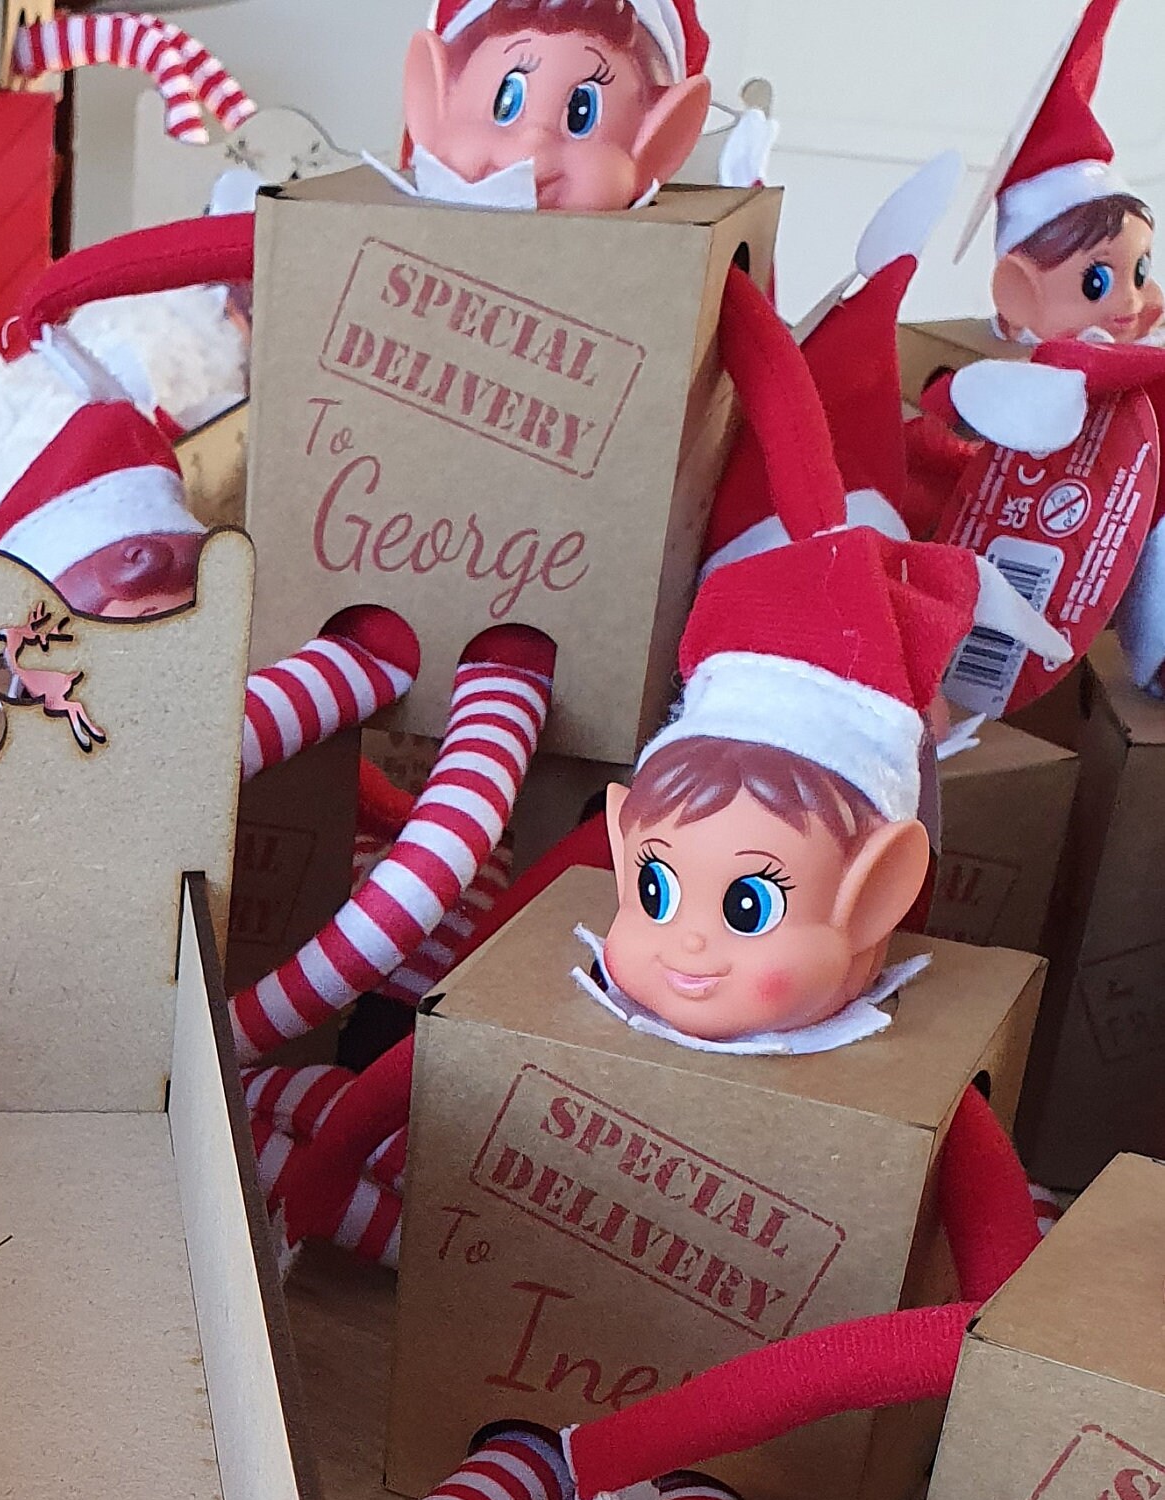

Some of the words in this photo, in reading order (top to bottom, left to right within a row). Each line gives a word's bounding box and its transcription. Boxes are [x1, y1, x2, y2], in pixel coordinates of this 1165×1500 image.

[335, 322, 596, 459] DELIVERY
[380, 263, 598, 387] SPECIAL
[307, 397, 354, 456] To
[312, 455, 590, 620] George
[440, 1205, 491, 1264] To
[489, 1142, 786, 1323] DELIVERY
[539, 1096, 791, 1258] SPECIAL
[483, 1280, 695, 1411] Ine
